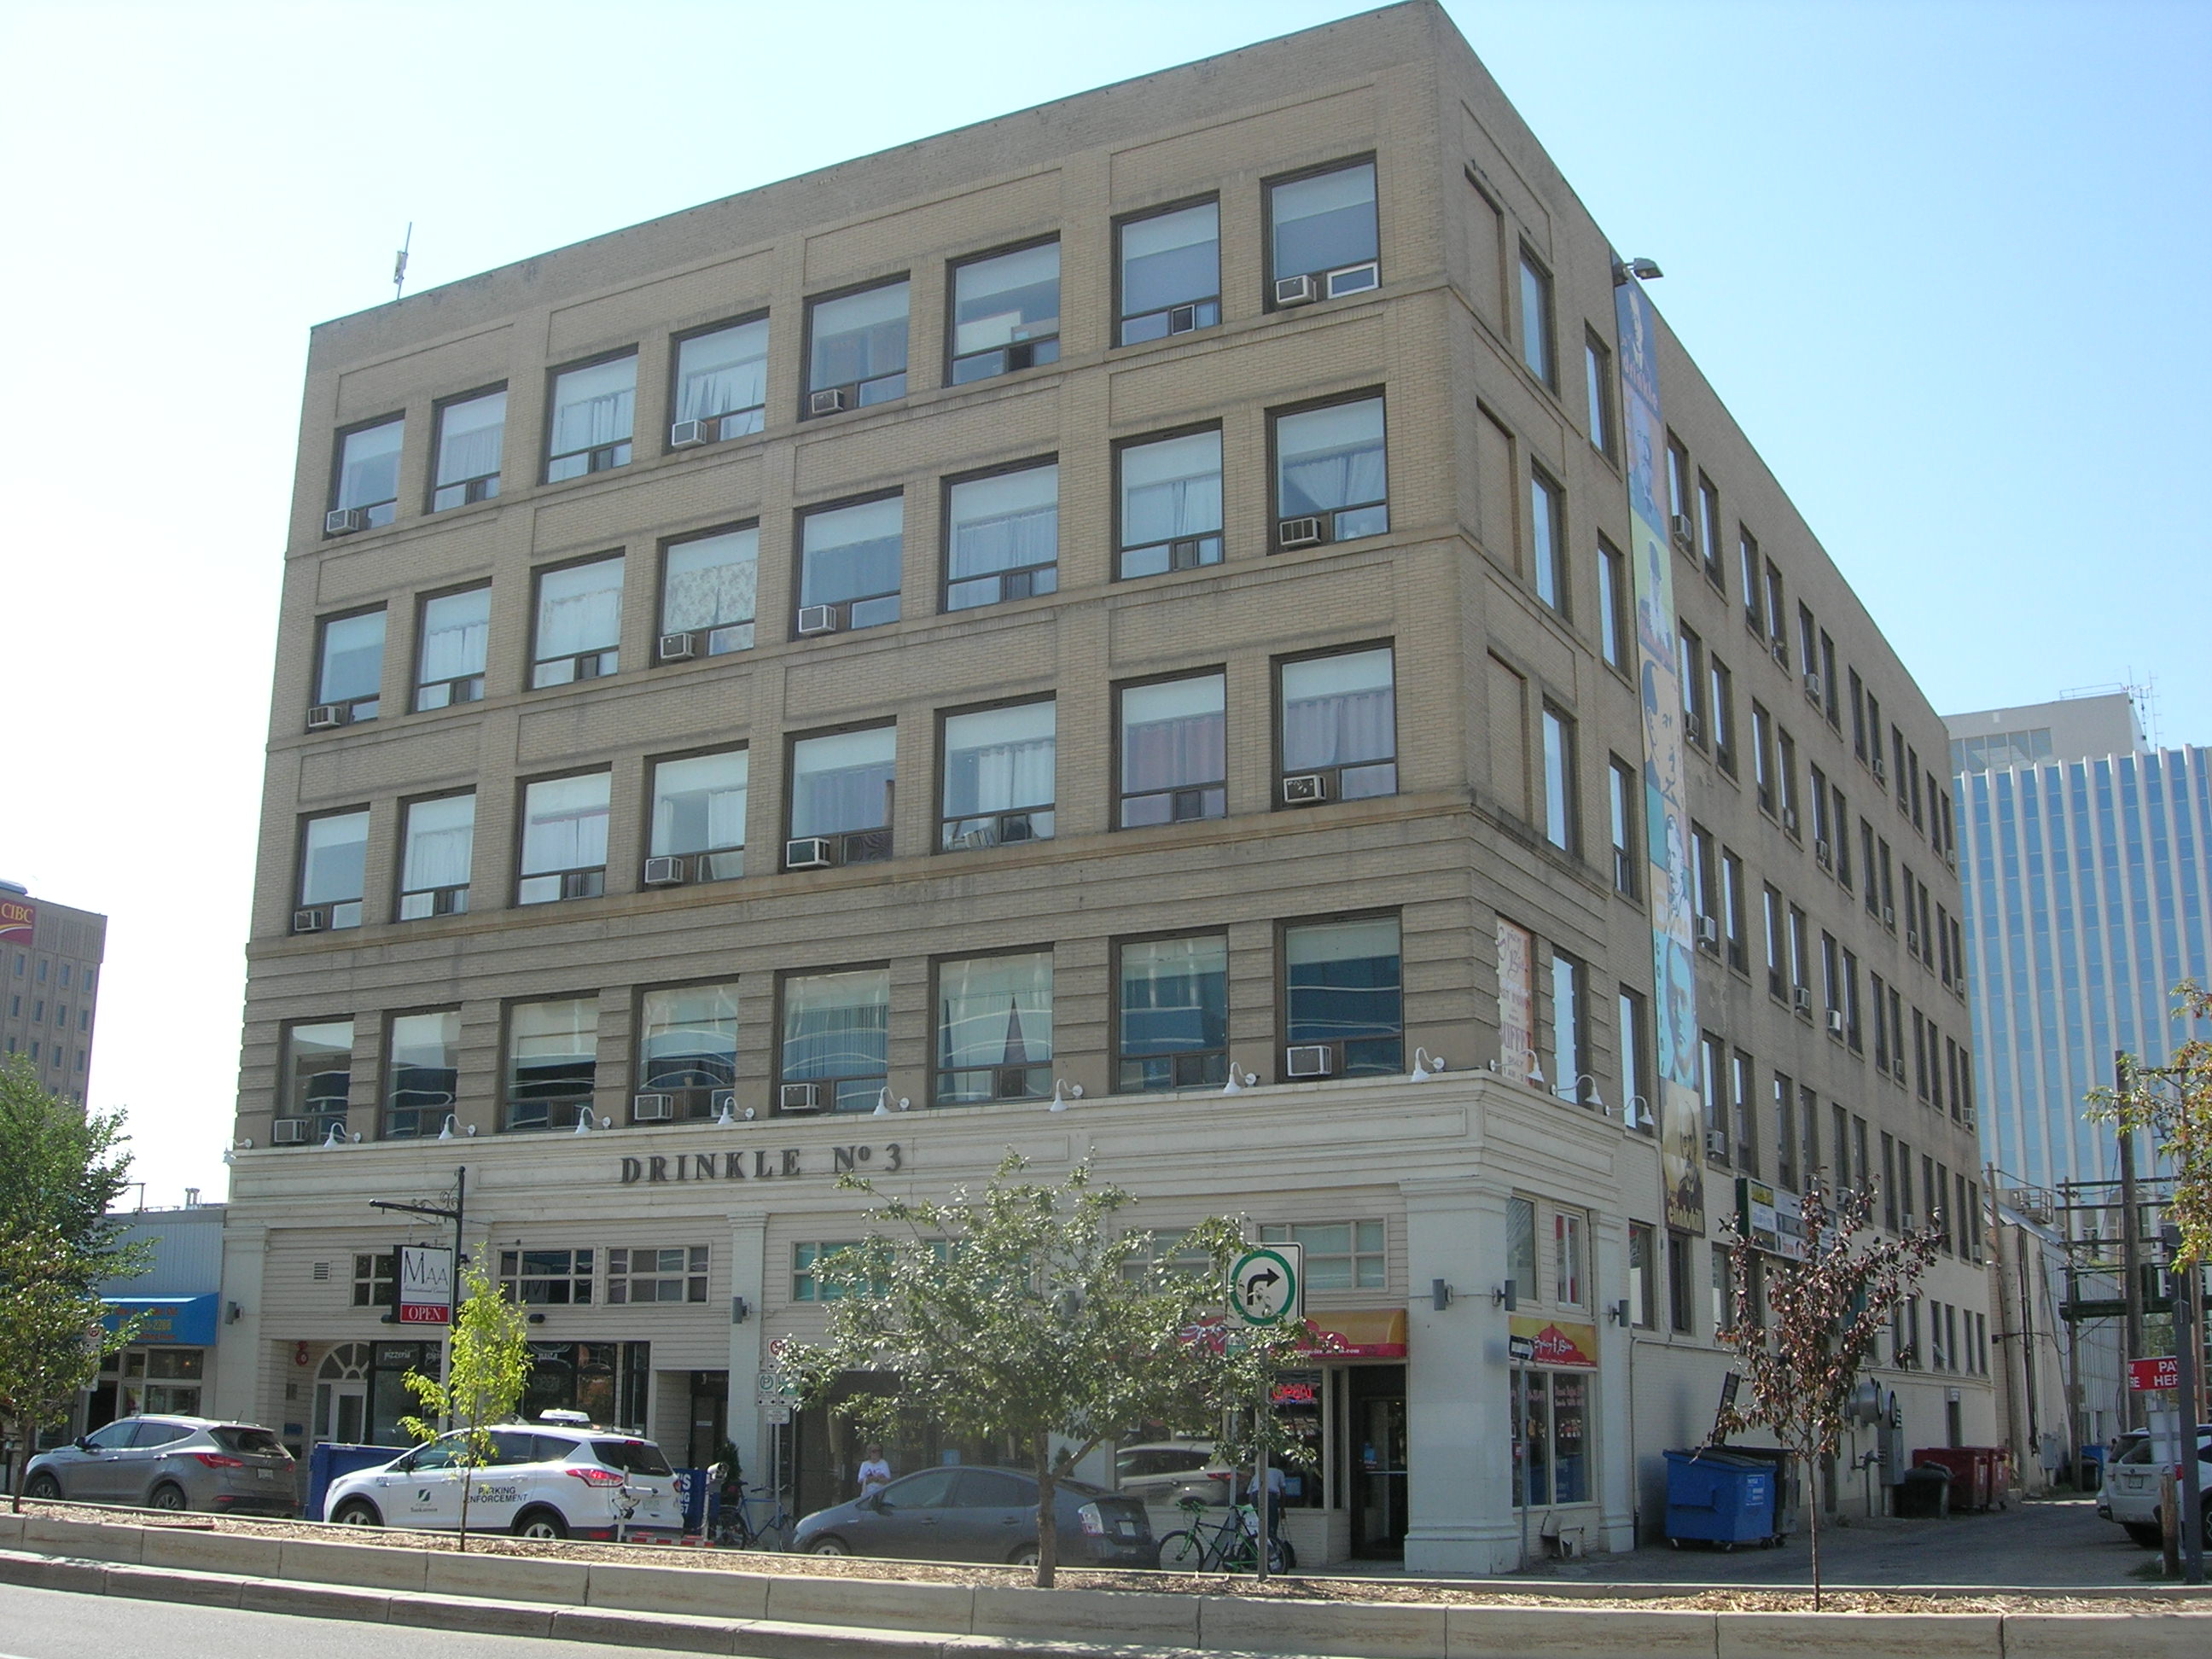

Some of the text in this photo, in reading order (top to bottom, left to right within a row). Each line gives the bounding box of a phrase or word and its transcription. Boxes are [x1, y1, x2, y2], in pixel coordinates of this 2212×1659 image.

[1, 902, 33, 923] CIBC
[620, 1148, 801, 1184] DRINKLE
[884, 1144, 902, 1172] 3
[408, 1307, 441, 1321] OPEN
[2153, 1374, 2178, 1388] HER
[478, 1487, 516, 1495] PRKING
